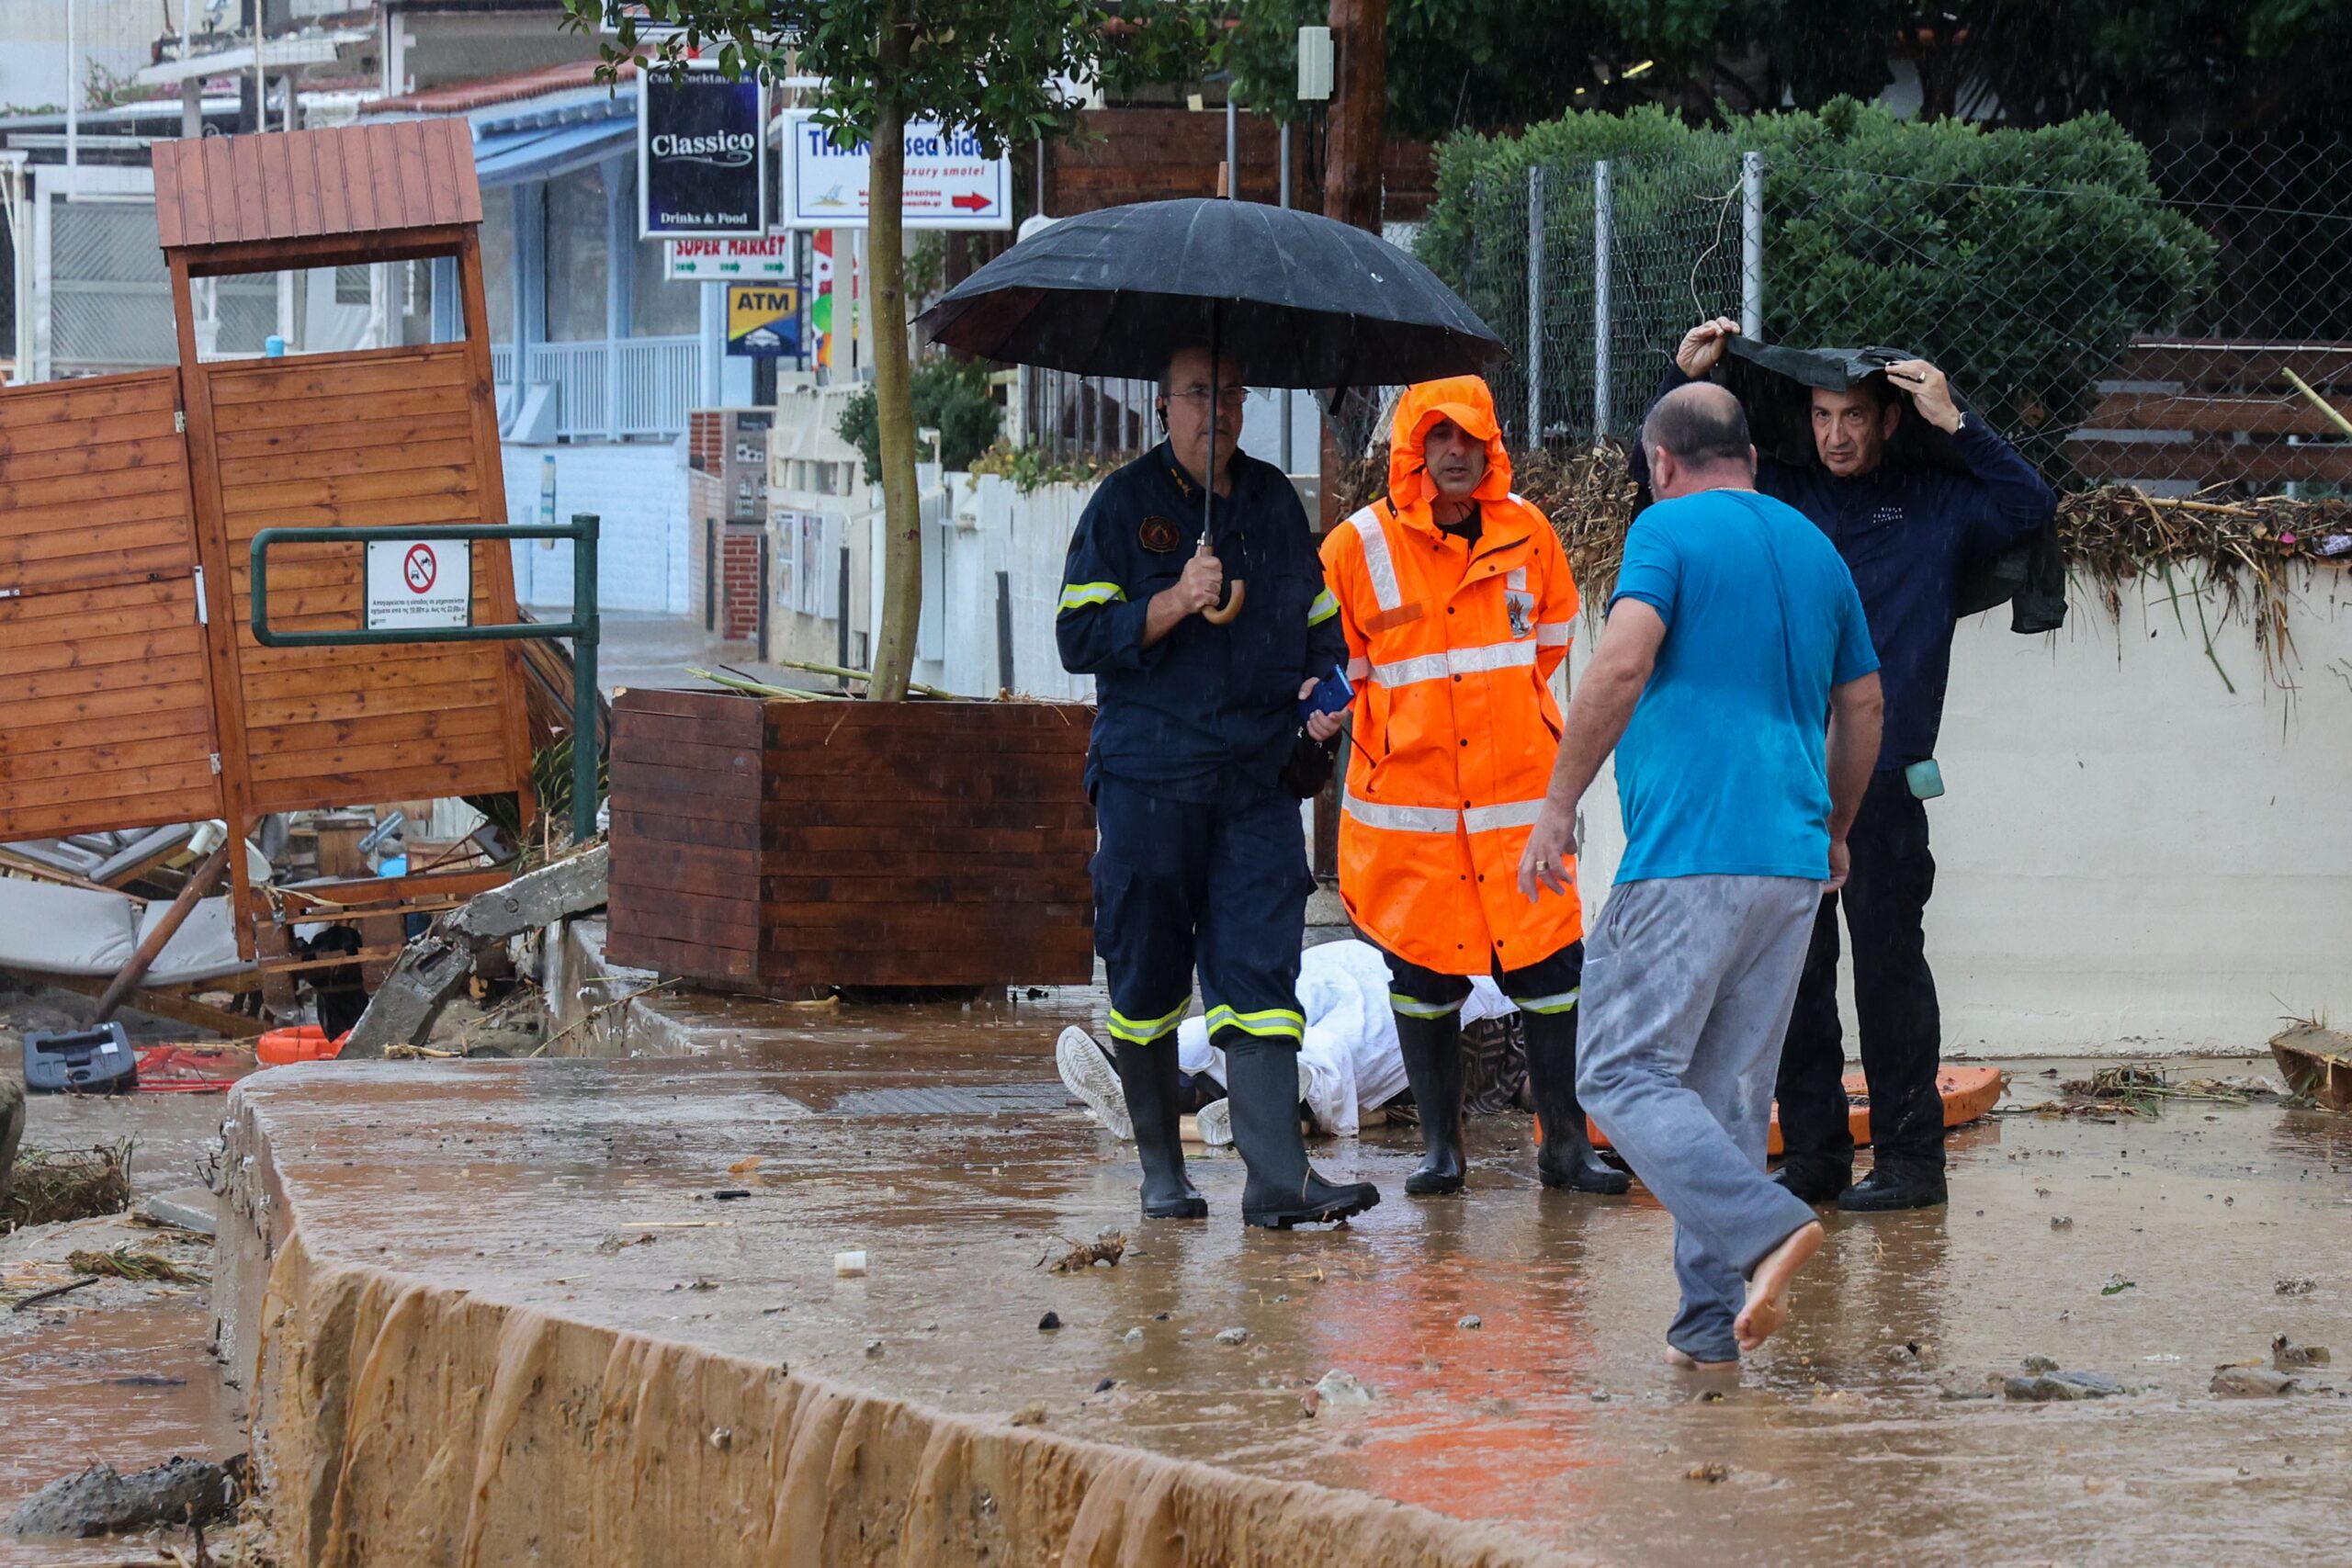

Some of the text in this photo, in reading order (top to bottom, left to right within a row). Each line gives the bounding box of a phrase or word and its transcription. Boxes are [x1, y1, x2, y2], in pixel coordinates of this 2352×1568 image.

[651, 130, 754, 156] Classico
[906, 137, 938, 156] sea
[903, 165, 985, 178] uxury smotel
[661, 212, 748, 224] Drinks & Food
[676, 236, 786, 256] SUPER MARKET
[737, 292, 790, 311] ATM
